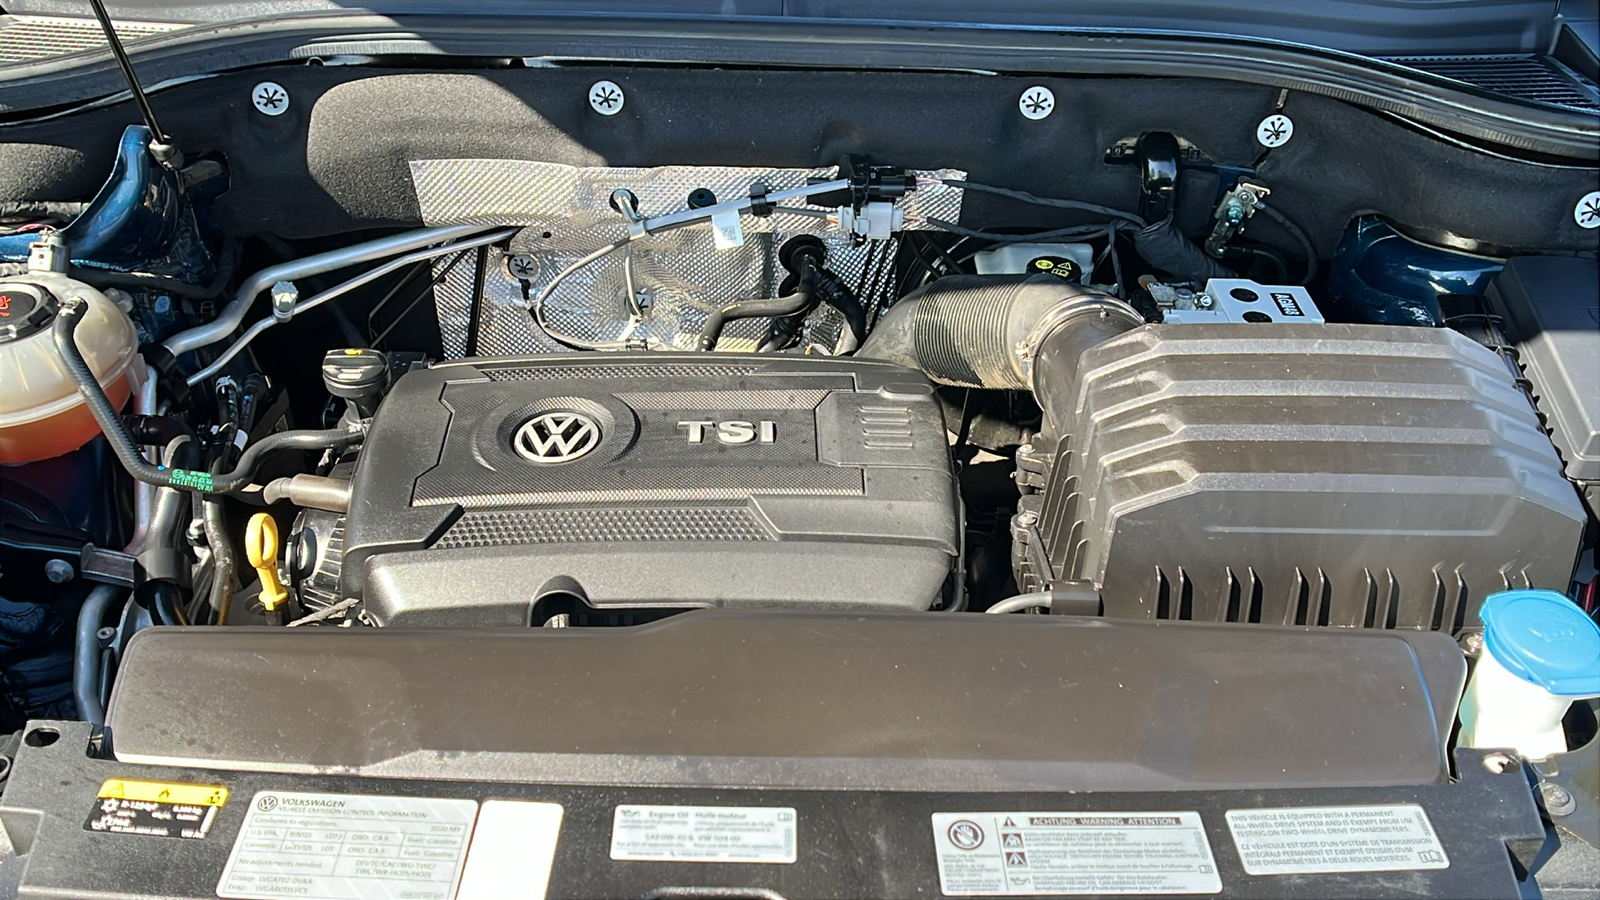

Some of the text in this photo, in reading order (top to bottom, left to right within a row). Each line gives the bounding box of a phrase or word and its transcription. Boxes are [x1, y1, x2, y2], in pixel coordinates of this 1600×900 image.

[677, 419, 776, 446] TSI
[282, 798, 346, 807] VOLKSWAGEN
[1032, 818, 1077, 826] ACHTUNG
[1081, 818, 1124, 826] WARNING
[1251, 842, 1286, 850] VÉHICULE
[1244, 850, 1280, 858] INTÉGRALE
[1282, 849, 1324, 857] PERMANENT
